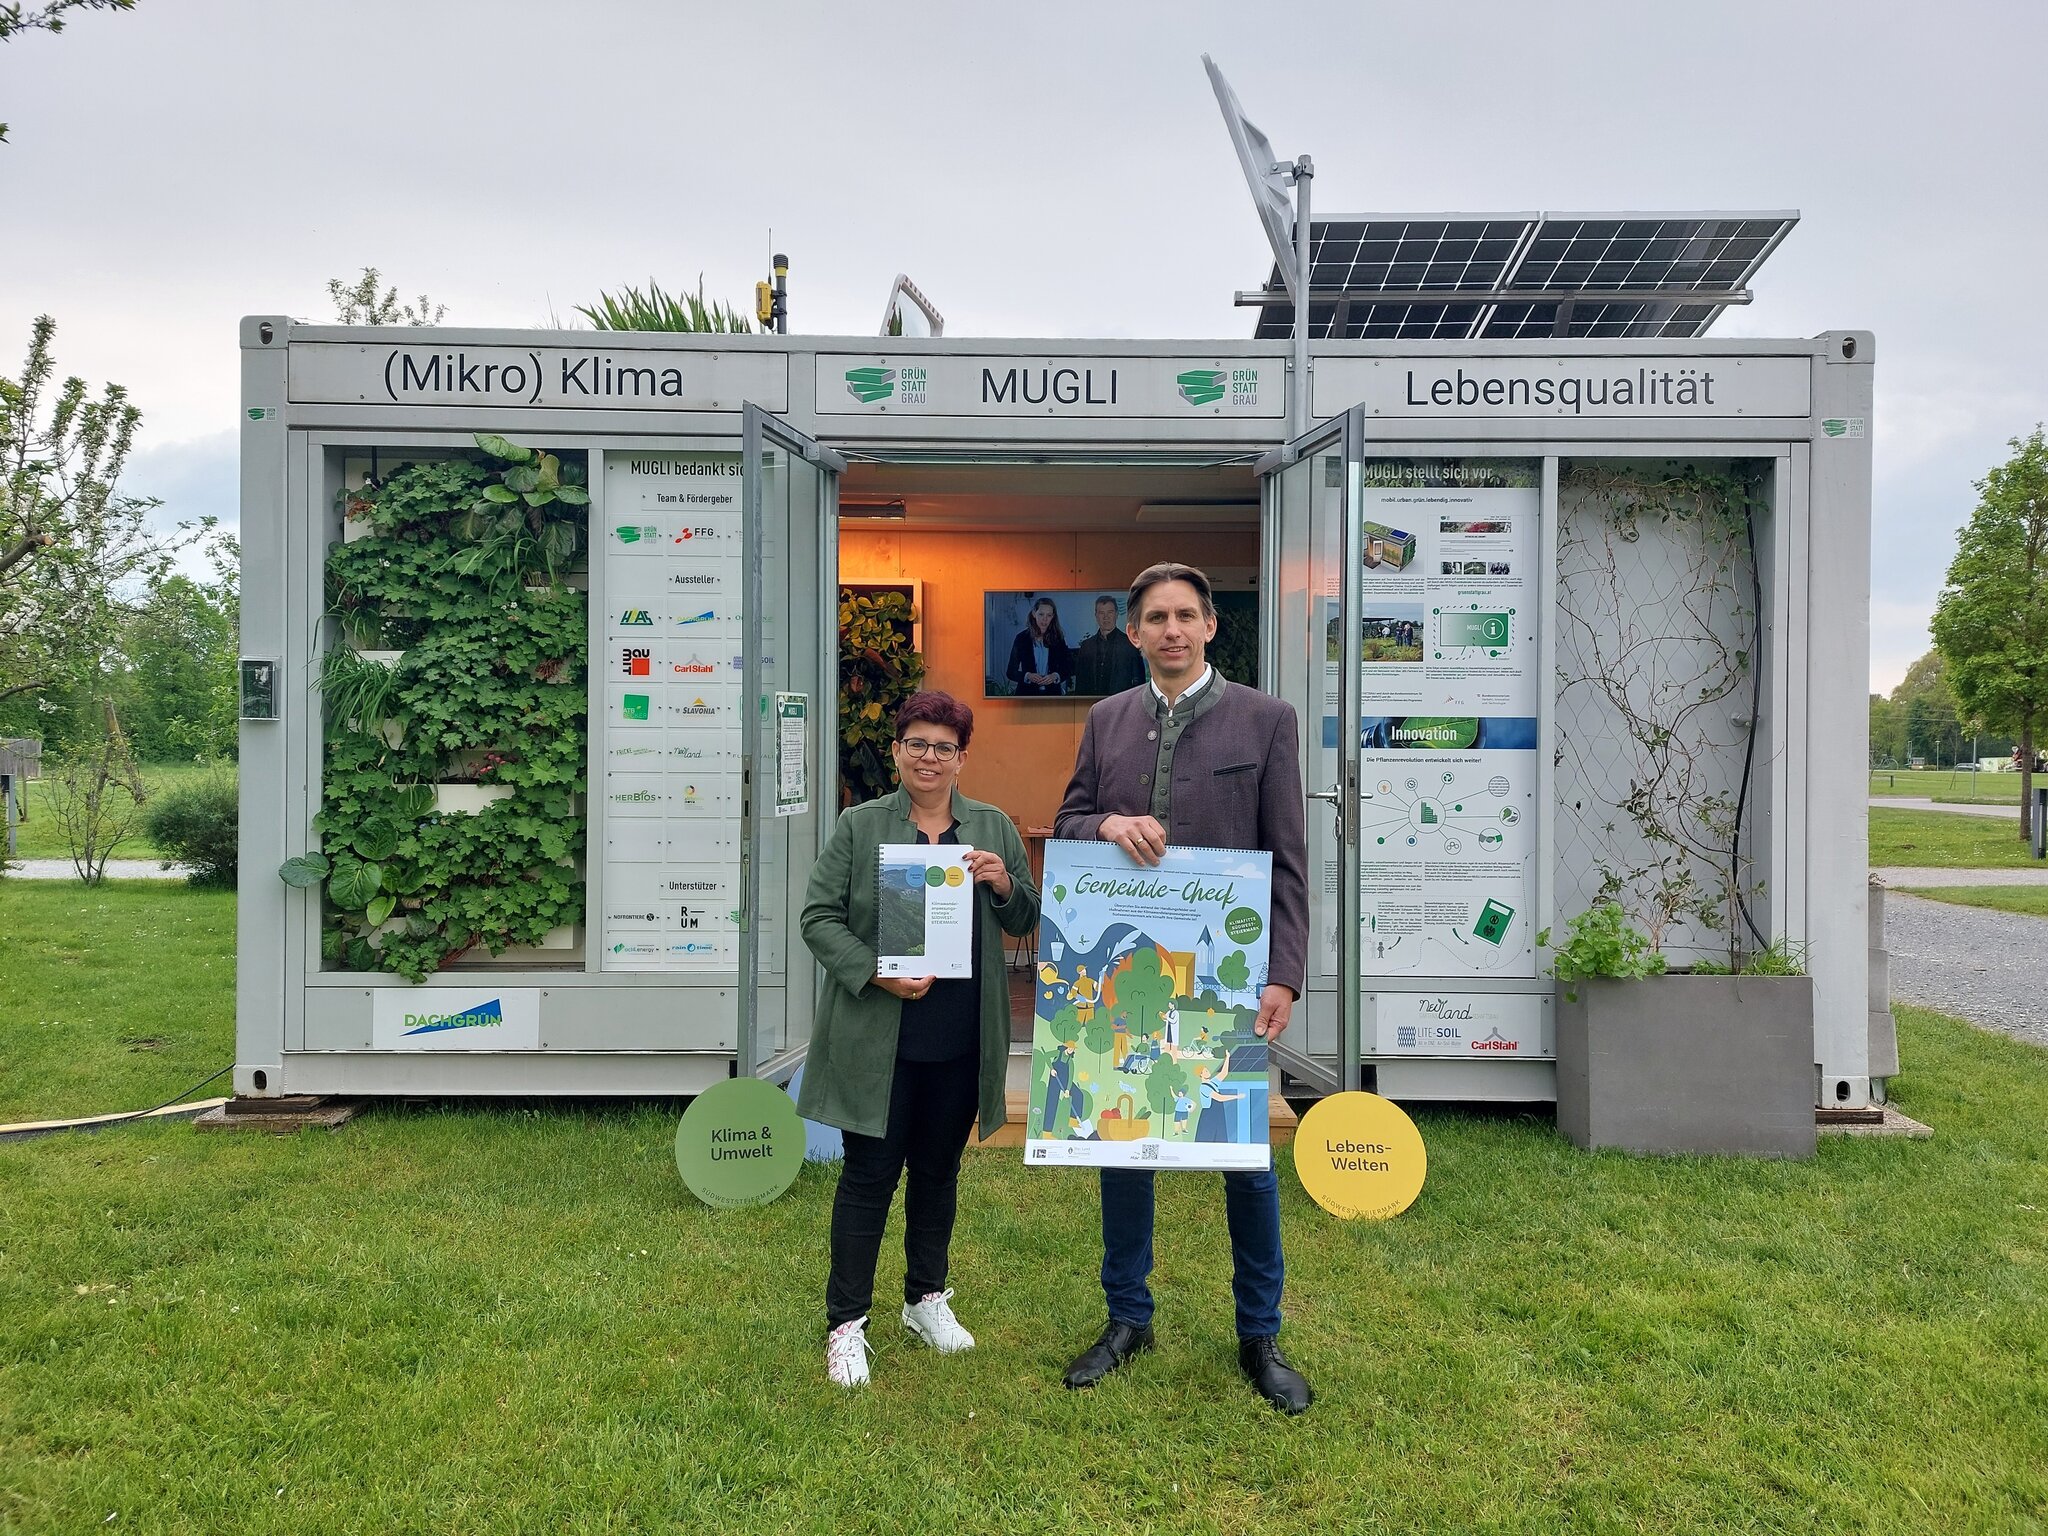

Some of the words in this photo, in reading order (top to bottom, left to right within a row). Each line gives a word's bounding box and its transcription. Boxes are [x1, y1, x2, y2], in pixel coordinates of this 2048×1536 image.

[384, 350, 543, 404] (Mikro)
[561, 356, 683, 397] Klima
[901, 366, 927, 380] GRÜN
[1232, 368, 1258, 381] GRÜN
[901, 380, 927, 392] STATT
[982, 368, 1118, 405] MUGLI
[1232, 382, 1258, 393] STATT
[1406, 368, 1715, 414] Lebensqualität
[901, 393, 926, 404] GRAU
[1232, 394, 1257, 405] GRAU
[631, 461, 670, 475] MUGLI
[675, 462, 725, 476] bedankt
[1364, 464, 1402, 479] MUGLI
[1406, 464, 1440, 479] stellt
[1443, 464, 1469, 479] sich
[1472, 467, 1493, 479] vor
[657, 493, 677, 503] Team
[679, 494, 685, 503] &
[687, 493, 733, 505] Fördergeber
[694, 528, 714, 536] FFG
[675, 574, 715, 584] Aussteller
[682, 706, 715, 715] SLAVONIA
[1391, 725, 1457, 741] Innovation
[669, 881, 717, 891] Unterstützer
[404, 1012, 501, 1027] DACHGRÜN
[1417, 1027, 1461, 1038] LITE-SOIL
[711, 1128, 757, 1143] Klima
[761, 1126, 772, 1140] &
[711, 1144, 773, 1161] Umwelt
[1326, 1139, 1392, 1154] Lebens-
[1331, 1157, 1389, 1171] Welten
